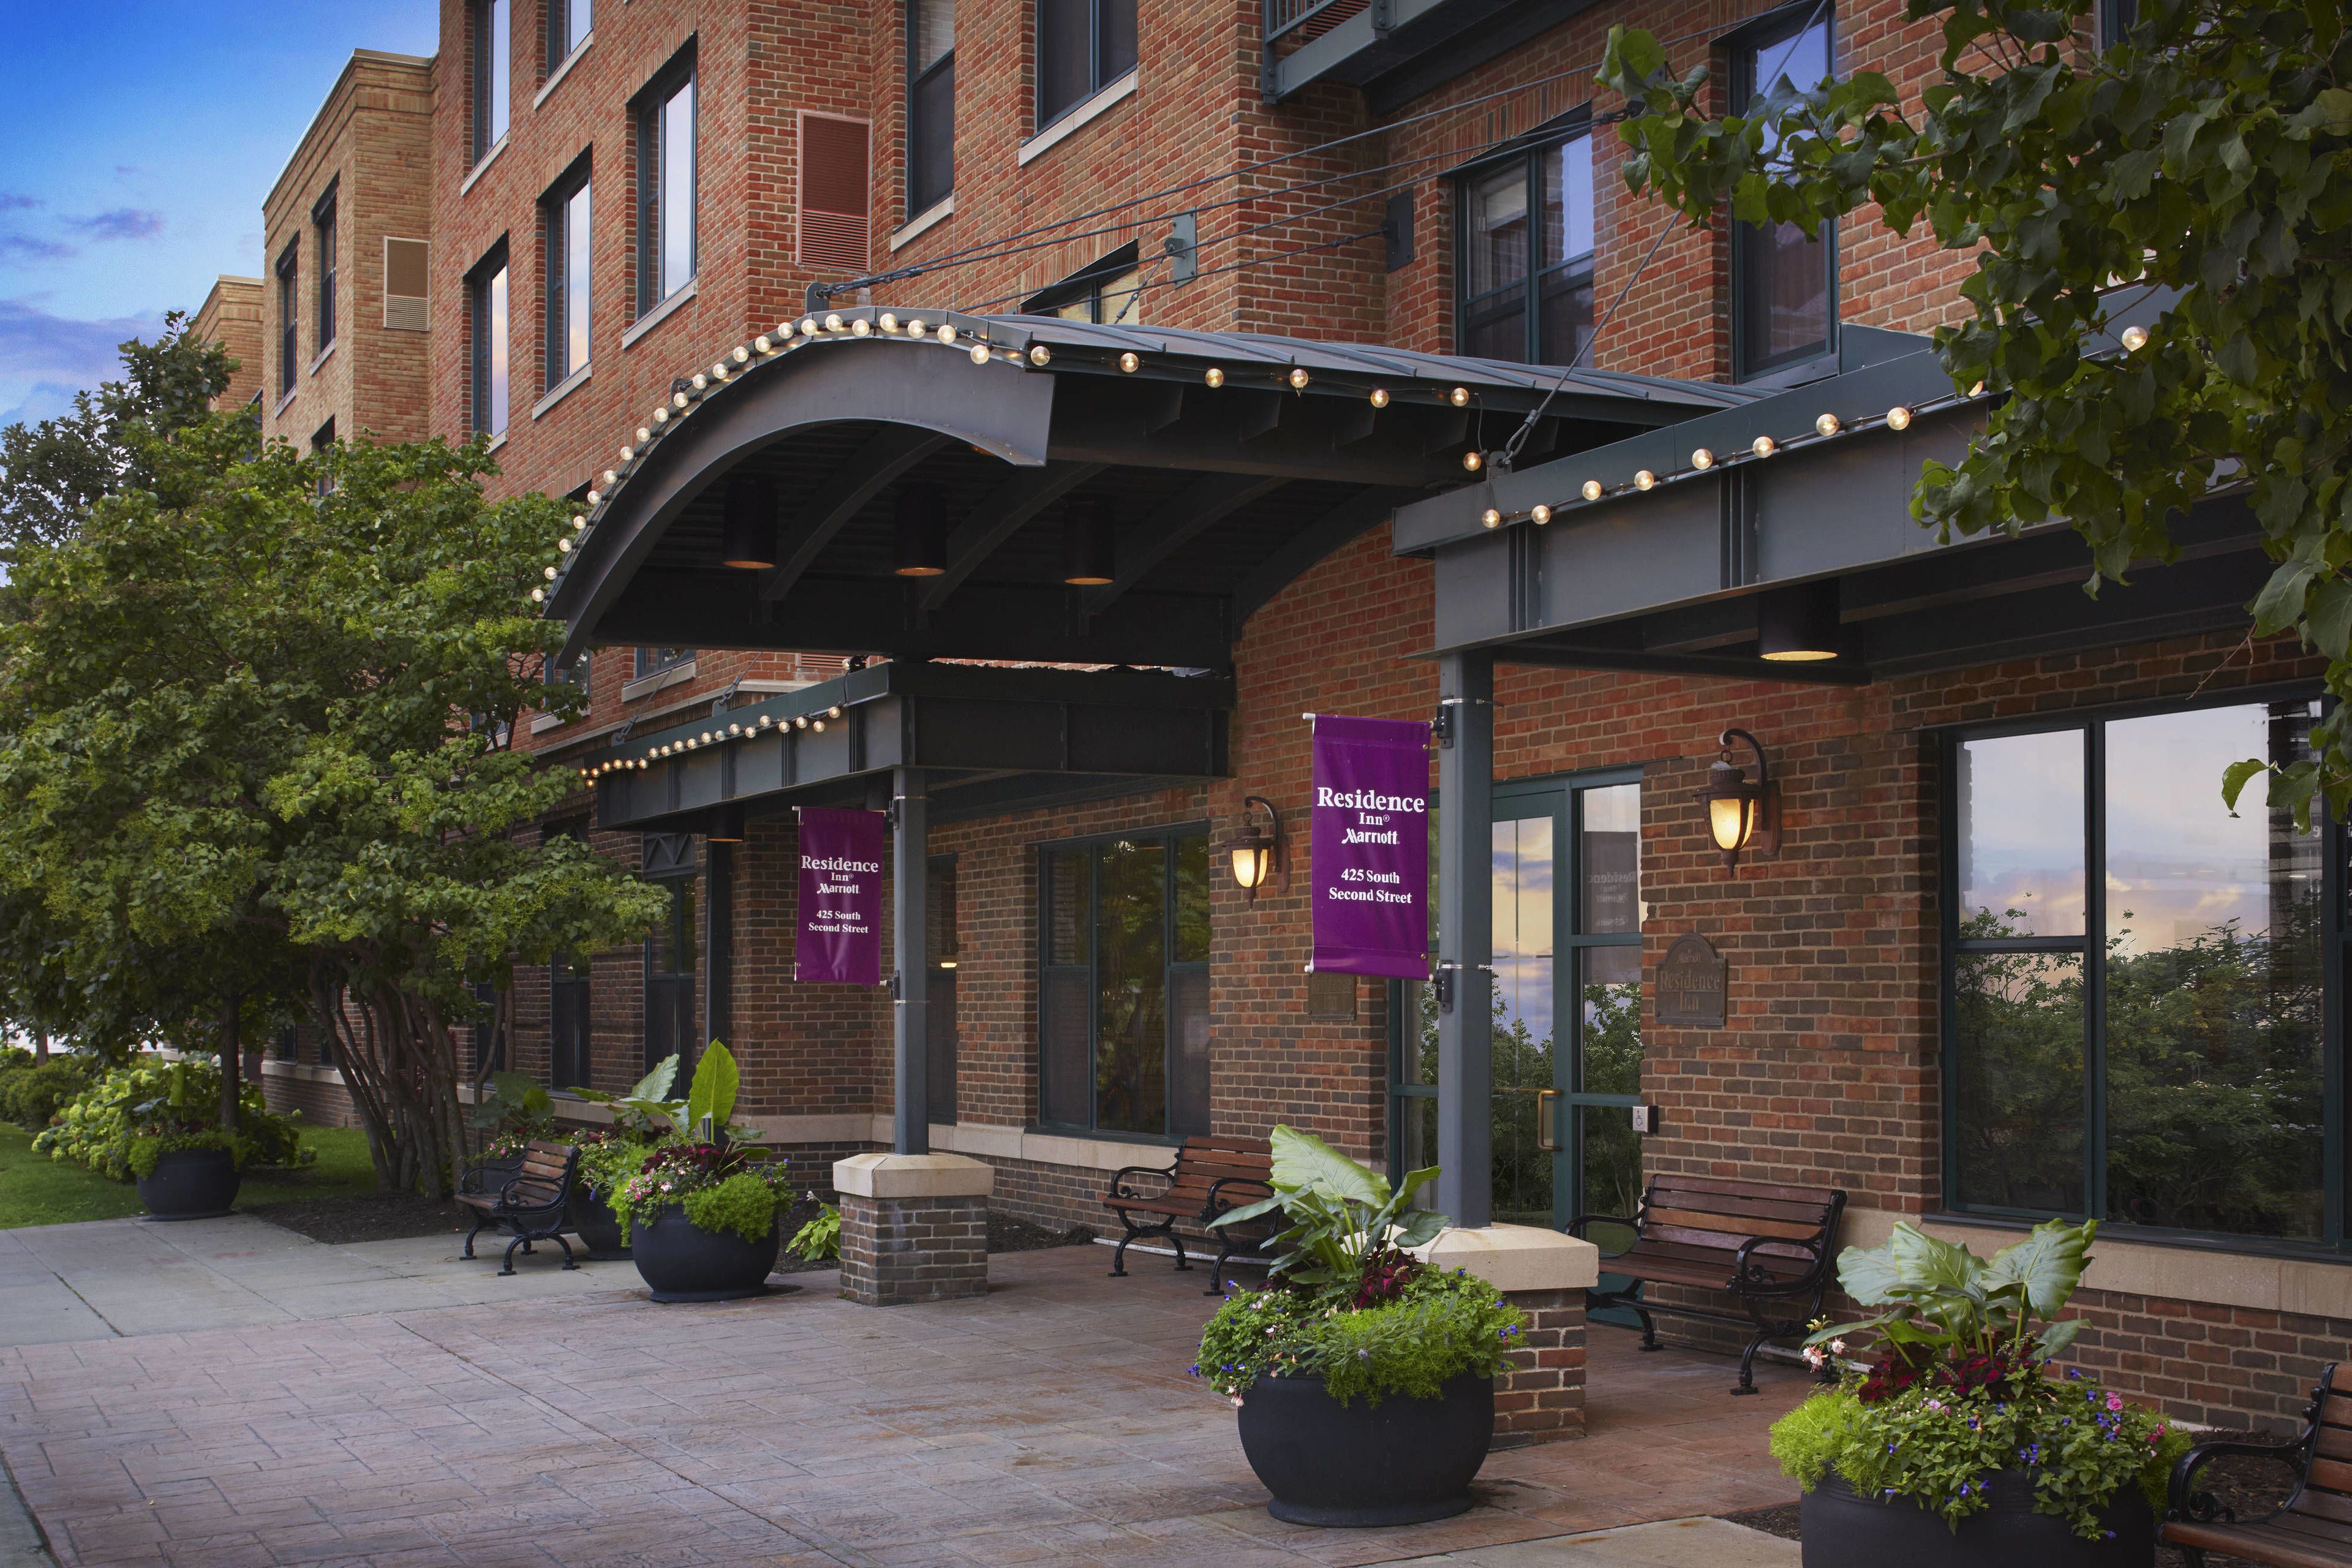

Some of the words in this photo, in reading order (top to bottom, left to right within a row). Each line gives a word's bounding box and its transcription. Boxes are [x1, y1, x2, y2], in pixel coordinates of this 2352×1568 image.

[1317, 786, 1425, 813] Residence
[1341, 827, 1398, 845] Marriott
[801, 855, 879, 873] Residence
[1341, 868, 1365, 882] 425
[1366, 870, 1400, 884] South
[816, 883, 860, 894] Marriott
[1329, 886, 1374, 902] Second
[1376, 889, 1412, 904] Street
[816, 910, 833, 919] 425
[834, 910, 861, 921] South
[808, 922, 840, 932] Second
[842, 923, 869, 934] Street
[1659, 969, 1721, 991] Residence
